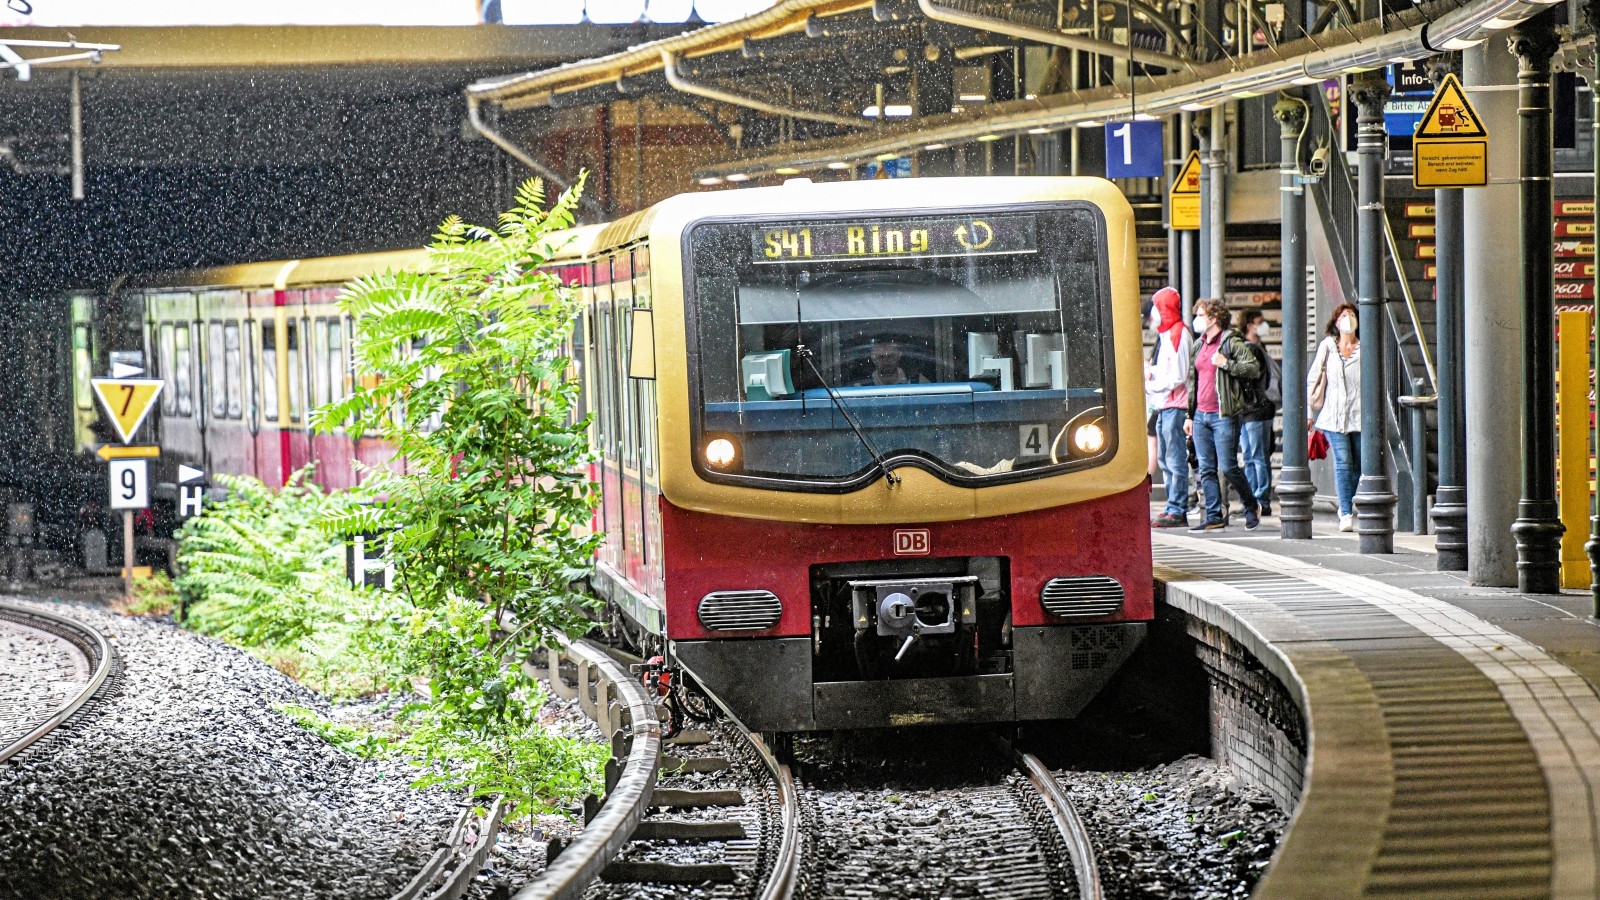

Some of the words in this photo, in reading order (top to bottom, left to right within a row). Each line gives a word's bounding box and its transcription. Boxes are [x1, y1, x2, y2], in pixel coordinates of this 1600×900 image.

[1401, 74, 1430, 86] Info-
[1391, 101, 1413, 111] Bitte
[1113, 123, 1132, 165] 1
[764, 228, 812, 258] S41
[847, 225, 929, 255] Ring
[120, 384, 136, 417] 7
[1024, 427, 1043, 455] 4
[121, 468, 136, 500] 9
[180, 486, 202, 517] H
[898, 533, 926, 551] DB
[353, 535, 395, 592] H
